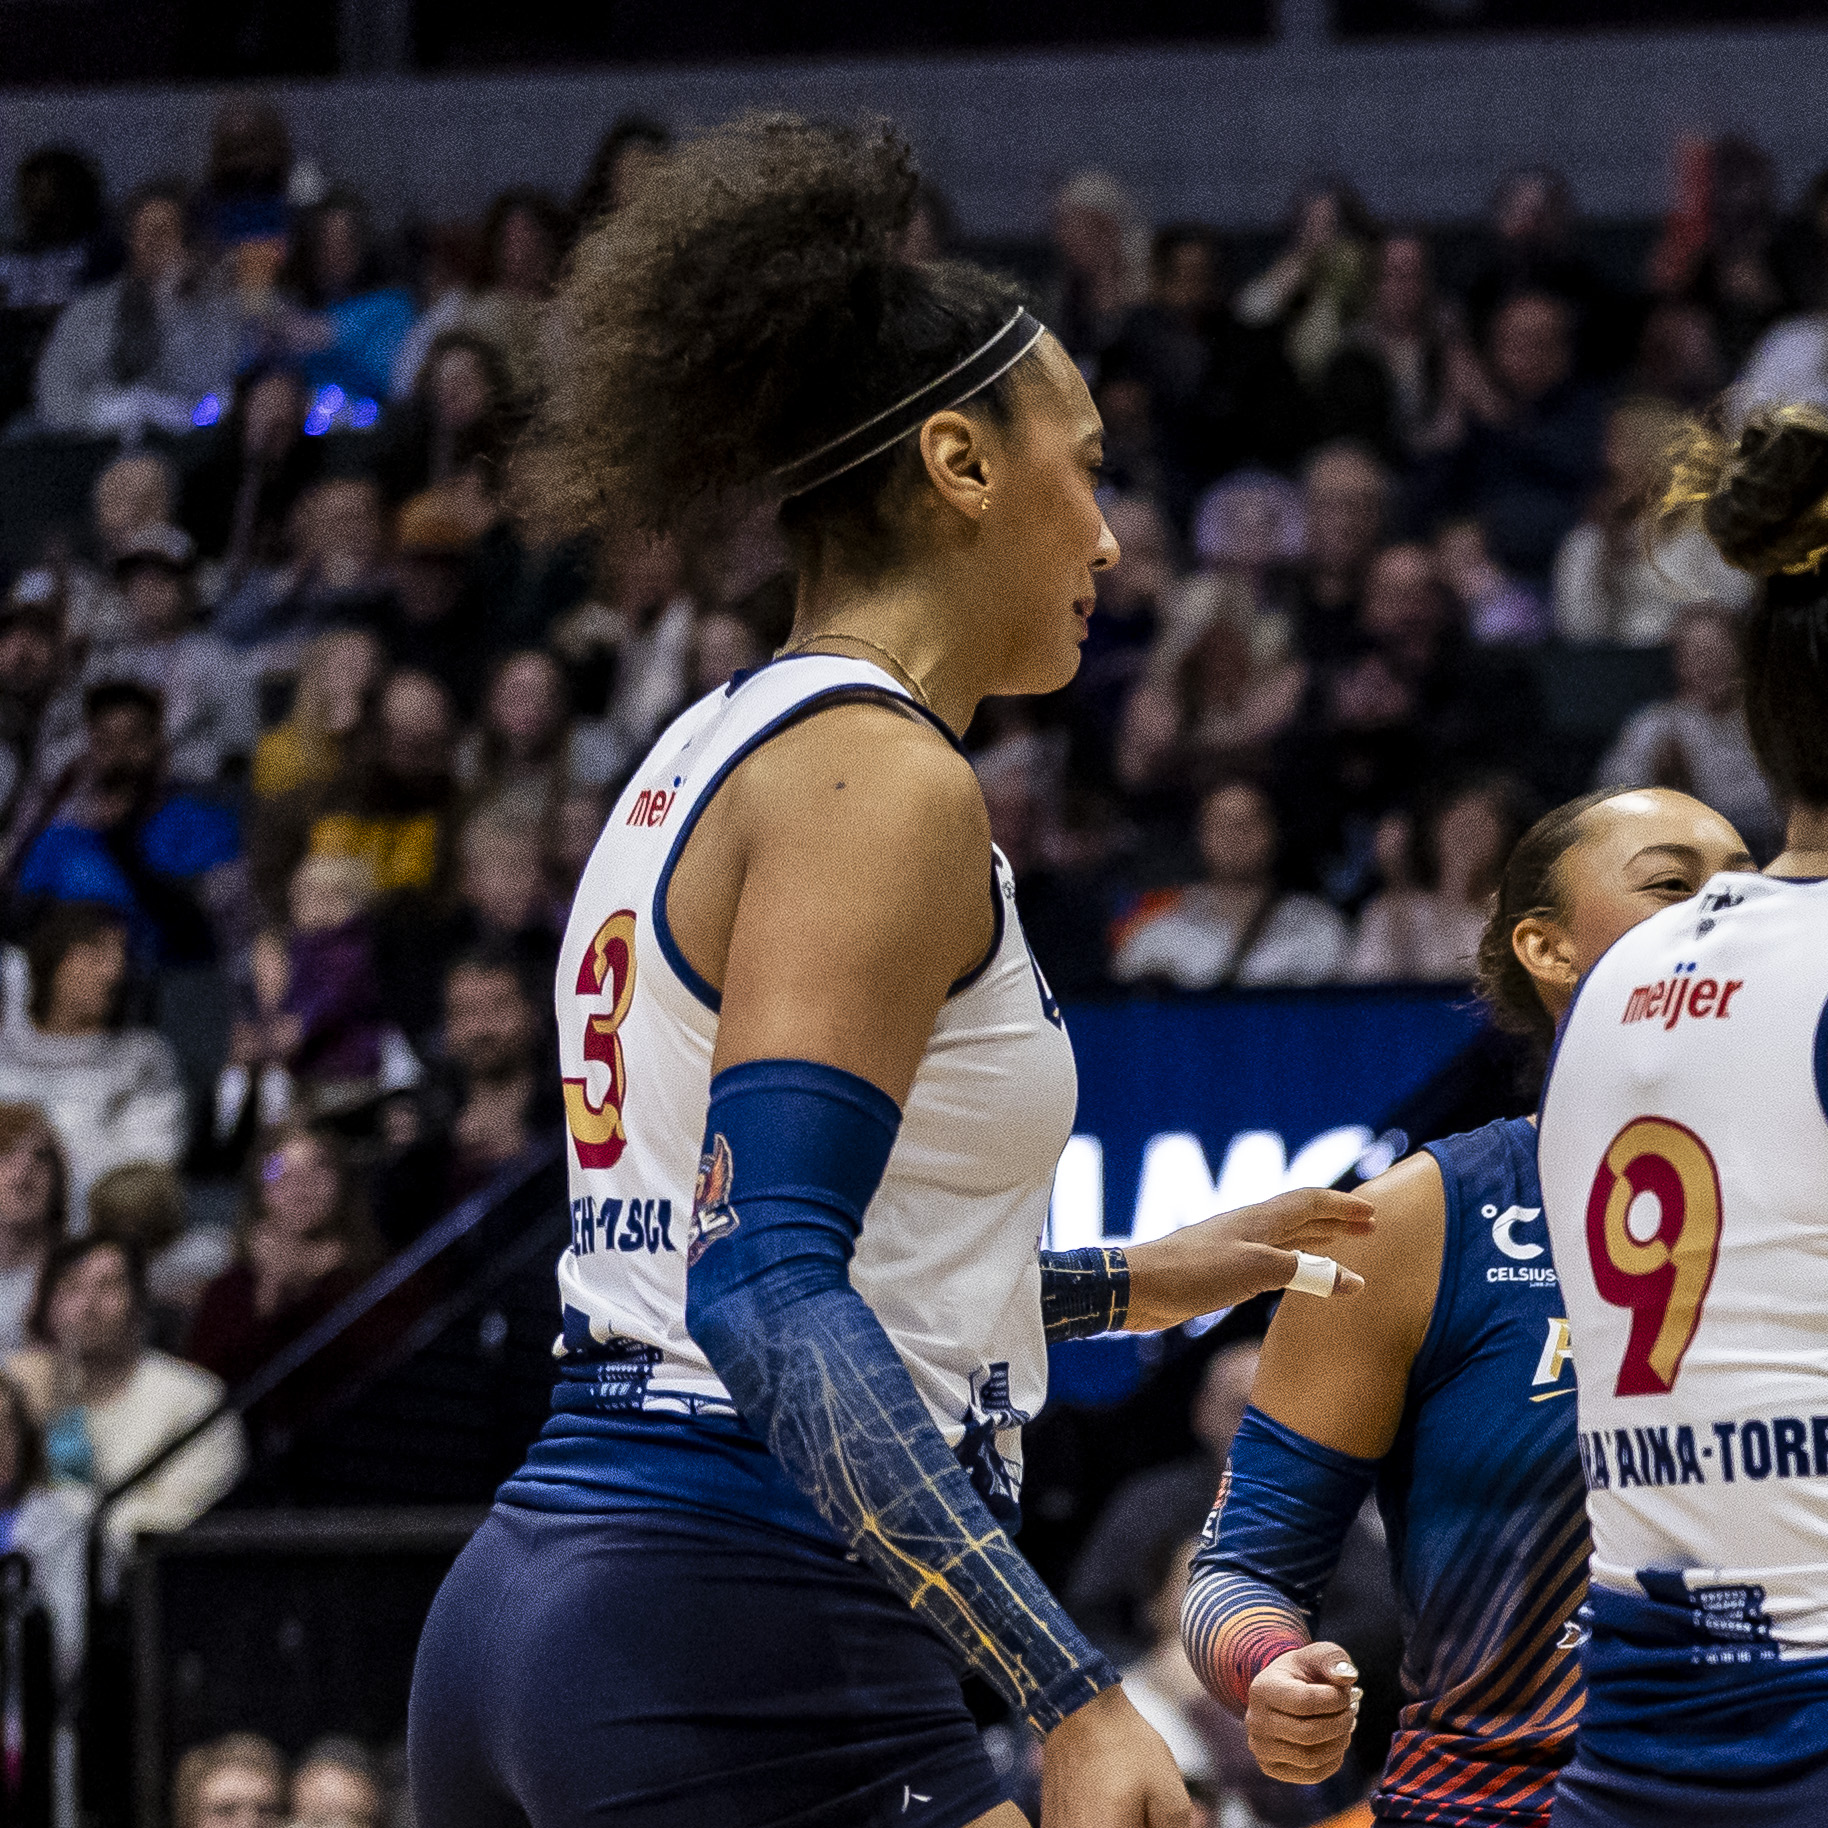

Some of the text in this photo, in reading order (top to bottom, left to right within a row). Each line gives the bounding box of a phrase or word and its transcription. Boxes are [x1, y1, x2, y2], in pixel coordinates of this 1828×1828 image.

[562, 909, 638, 1169] 3
[1621, 962, 1743, 1031] meijer
[1486, 1266, 1557, 1283] CELSIUS
[1585, 1115, 1723, 1397] 9
